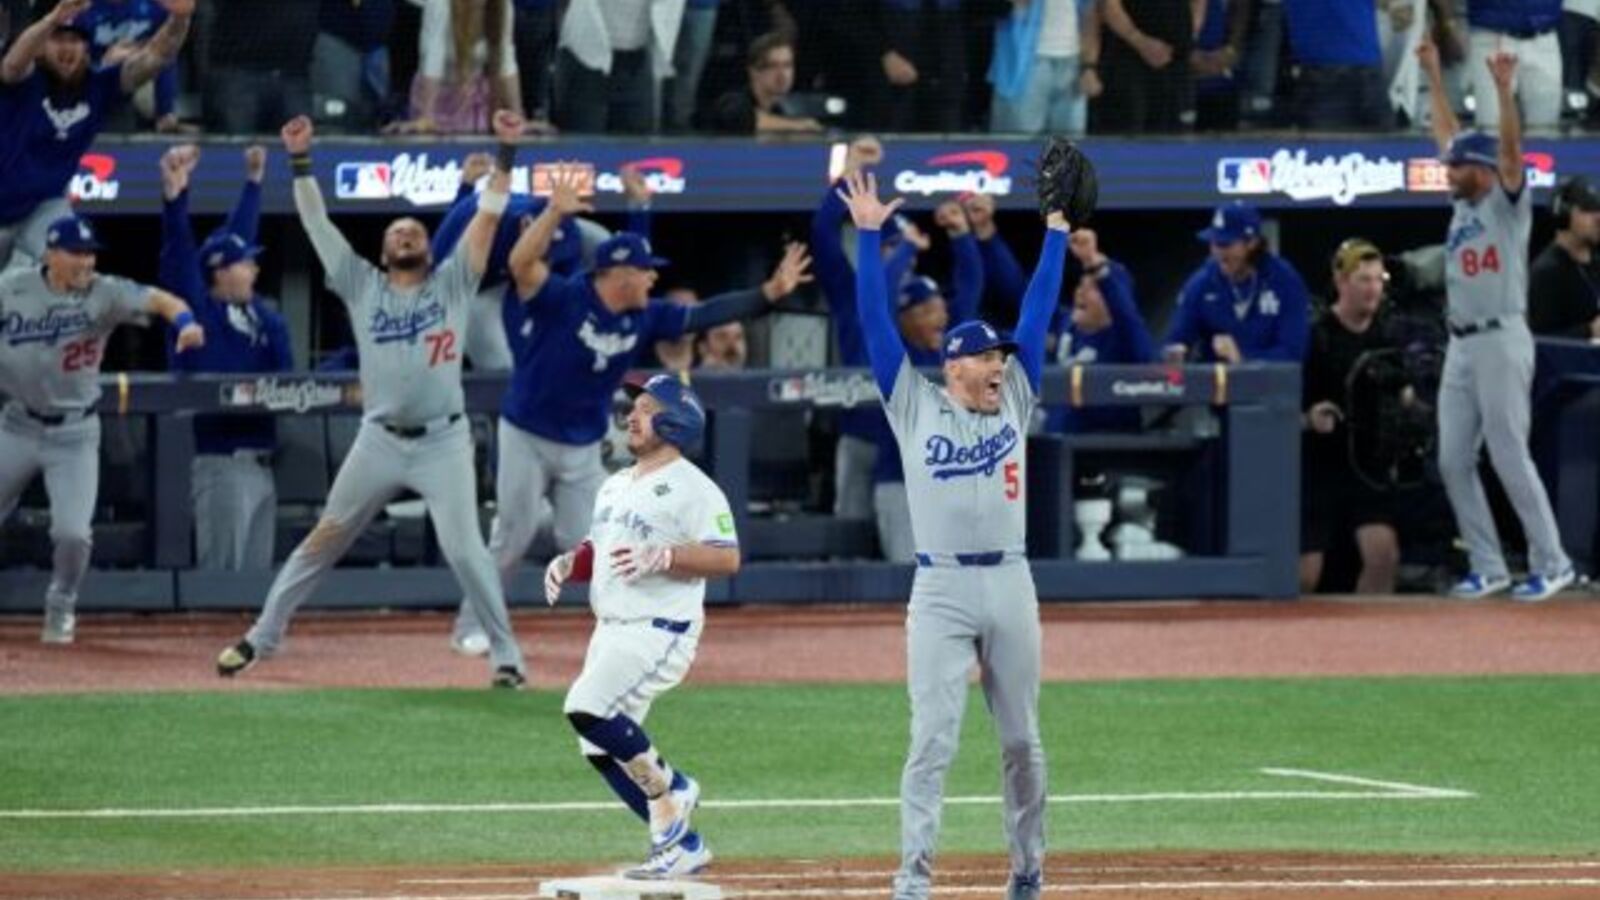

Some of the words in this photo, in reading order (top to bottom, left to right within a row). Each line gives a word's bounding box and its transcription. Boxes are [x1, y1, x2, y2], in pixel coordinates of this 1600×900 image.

[1271, 148, 1340, 201] World
[1461, 245, 1500, 278] 84
[6, 307, 93, 347] Dodgers
[369, 302, 447, 346] Dodgers
[61, 338, 99, 373] 25
[424, 330, 456, 368] 72
[924, 423, 1017, 481] Dodgers
[1003, 461, 1019, 501] 5
